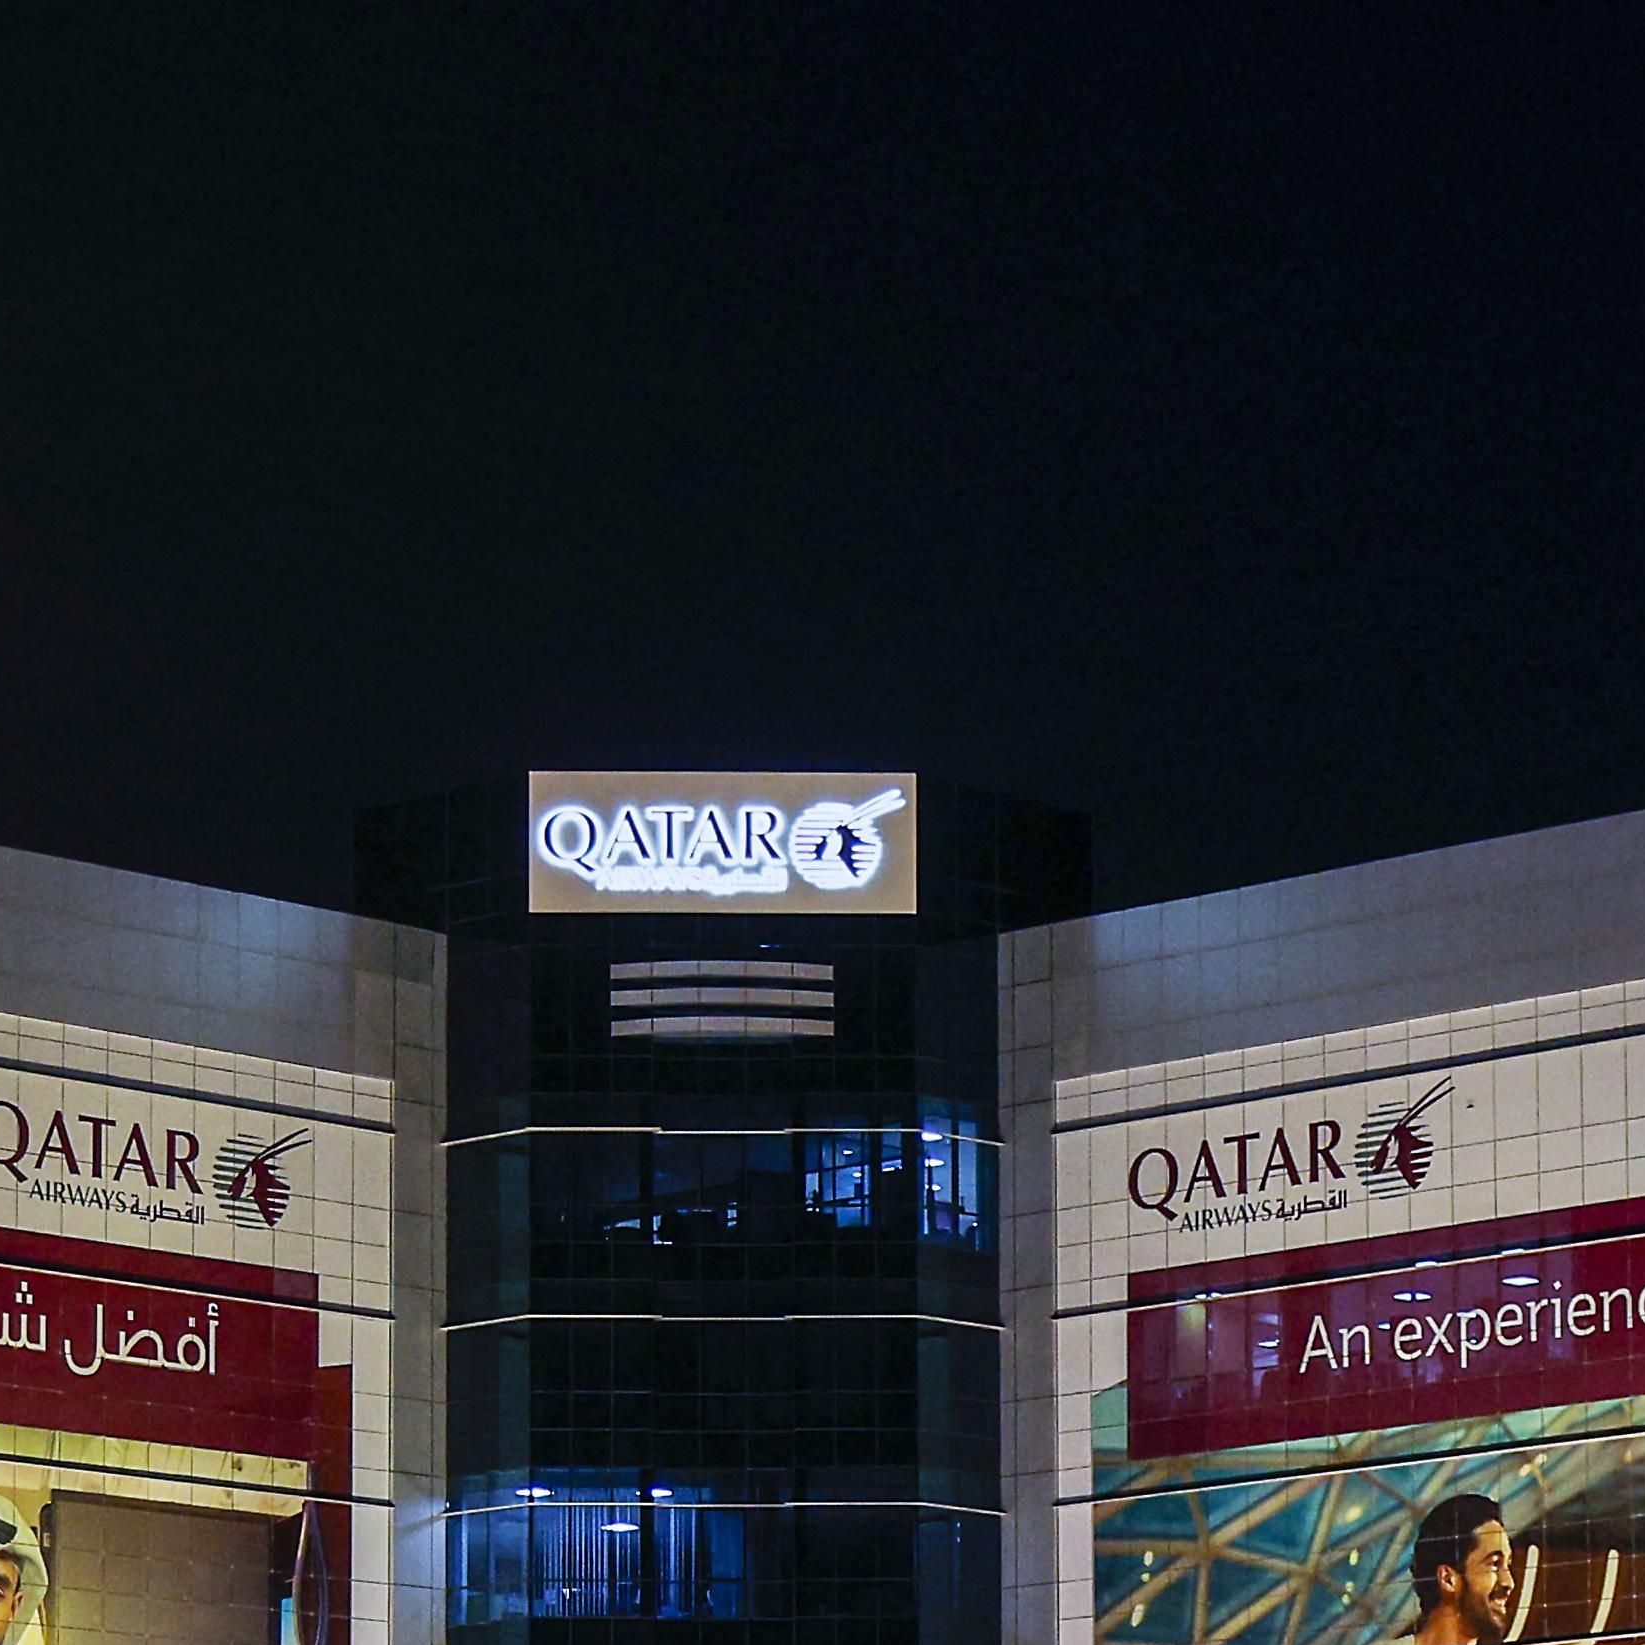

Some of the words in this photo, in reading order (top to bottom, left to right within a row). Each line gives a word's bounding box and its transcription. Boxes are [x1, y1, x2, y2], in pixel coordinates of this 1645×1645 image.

[541, 807, 786, 874] QATAR
[1127, 1118, 1347, 1222] QATAR
[29, 1178, 127, 1214] AIRWAYS
[129, 1193, 205, 1226] القطرية
[1178, 1198, 1273, 1234] AIRWAYS
[1274, 1189, 1348, 1222] القطرية
[63, 1302, 220, 1376] أفضل
[1300, 1314, 1372, 1374] An
